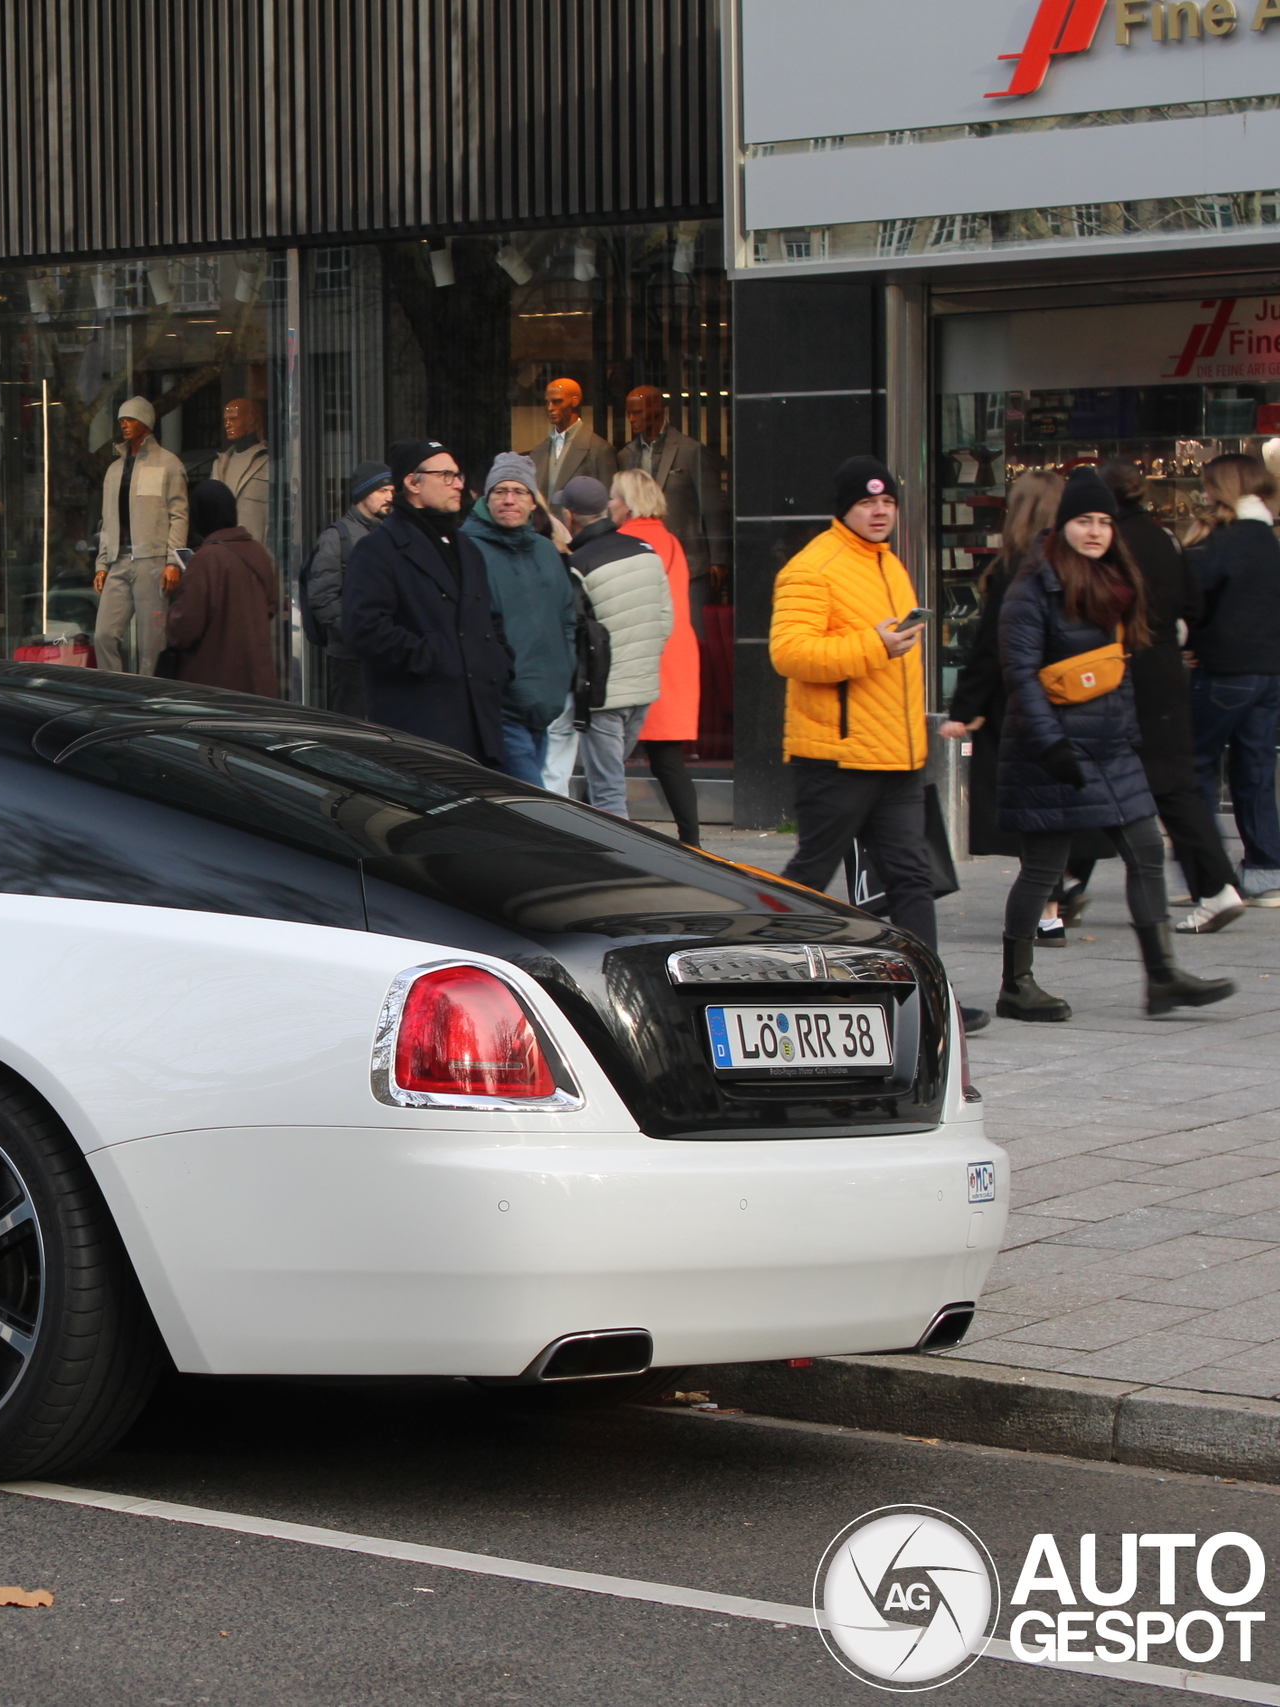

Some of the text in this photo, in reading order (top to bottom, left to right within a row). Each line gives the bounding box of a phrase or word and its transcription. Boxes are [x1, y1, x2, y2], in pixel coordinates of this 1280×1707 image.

[1115, 0, 1237, 46] Fine
[1197, 365, 1213, 378] DIE
[1216, 364, 1244, 377] FEINE
[1247, 363, 1266, 376] ART
[736, 1013, 875, 1059] LÖ RR 38
[717, 1044, 725, 1057] D
[975, 1167, 988, 1192] MC
